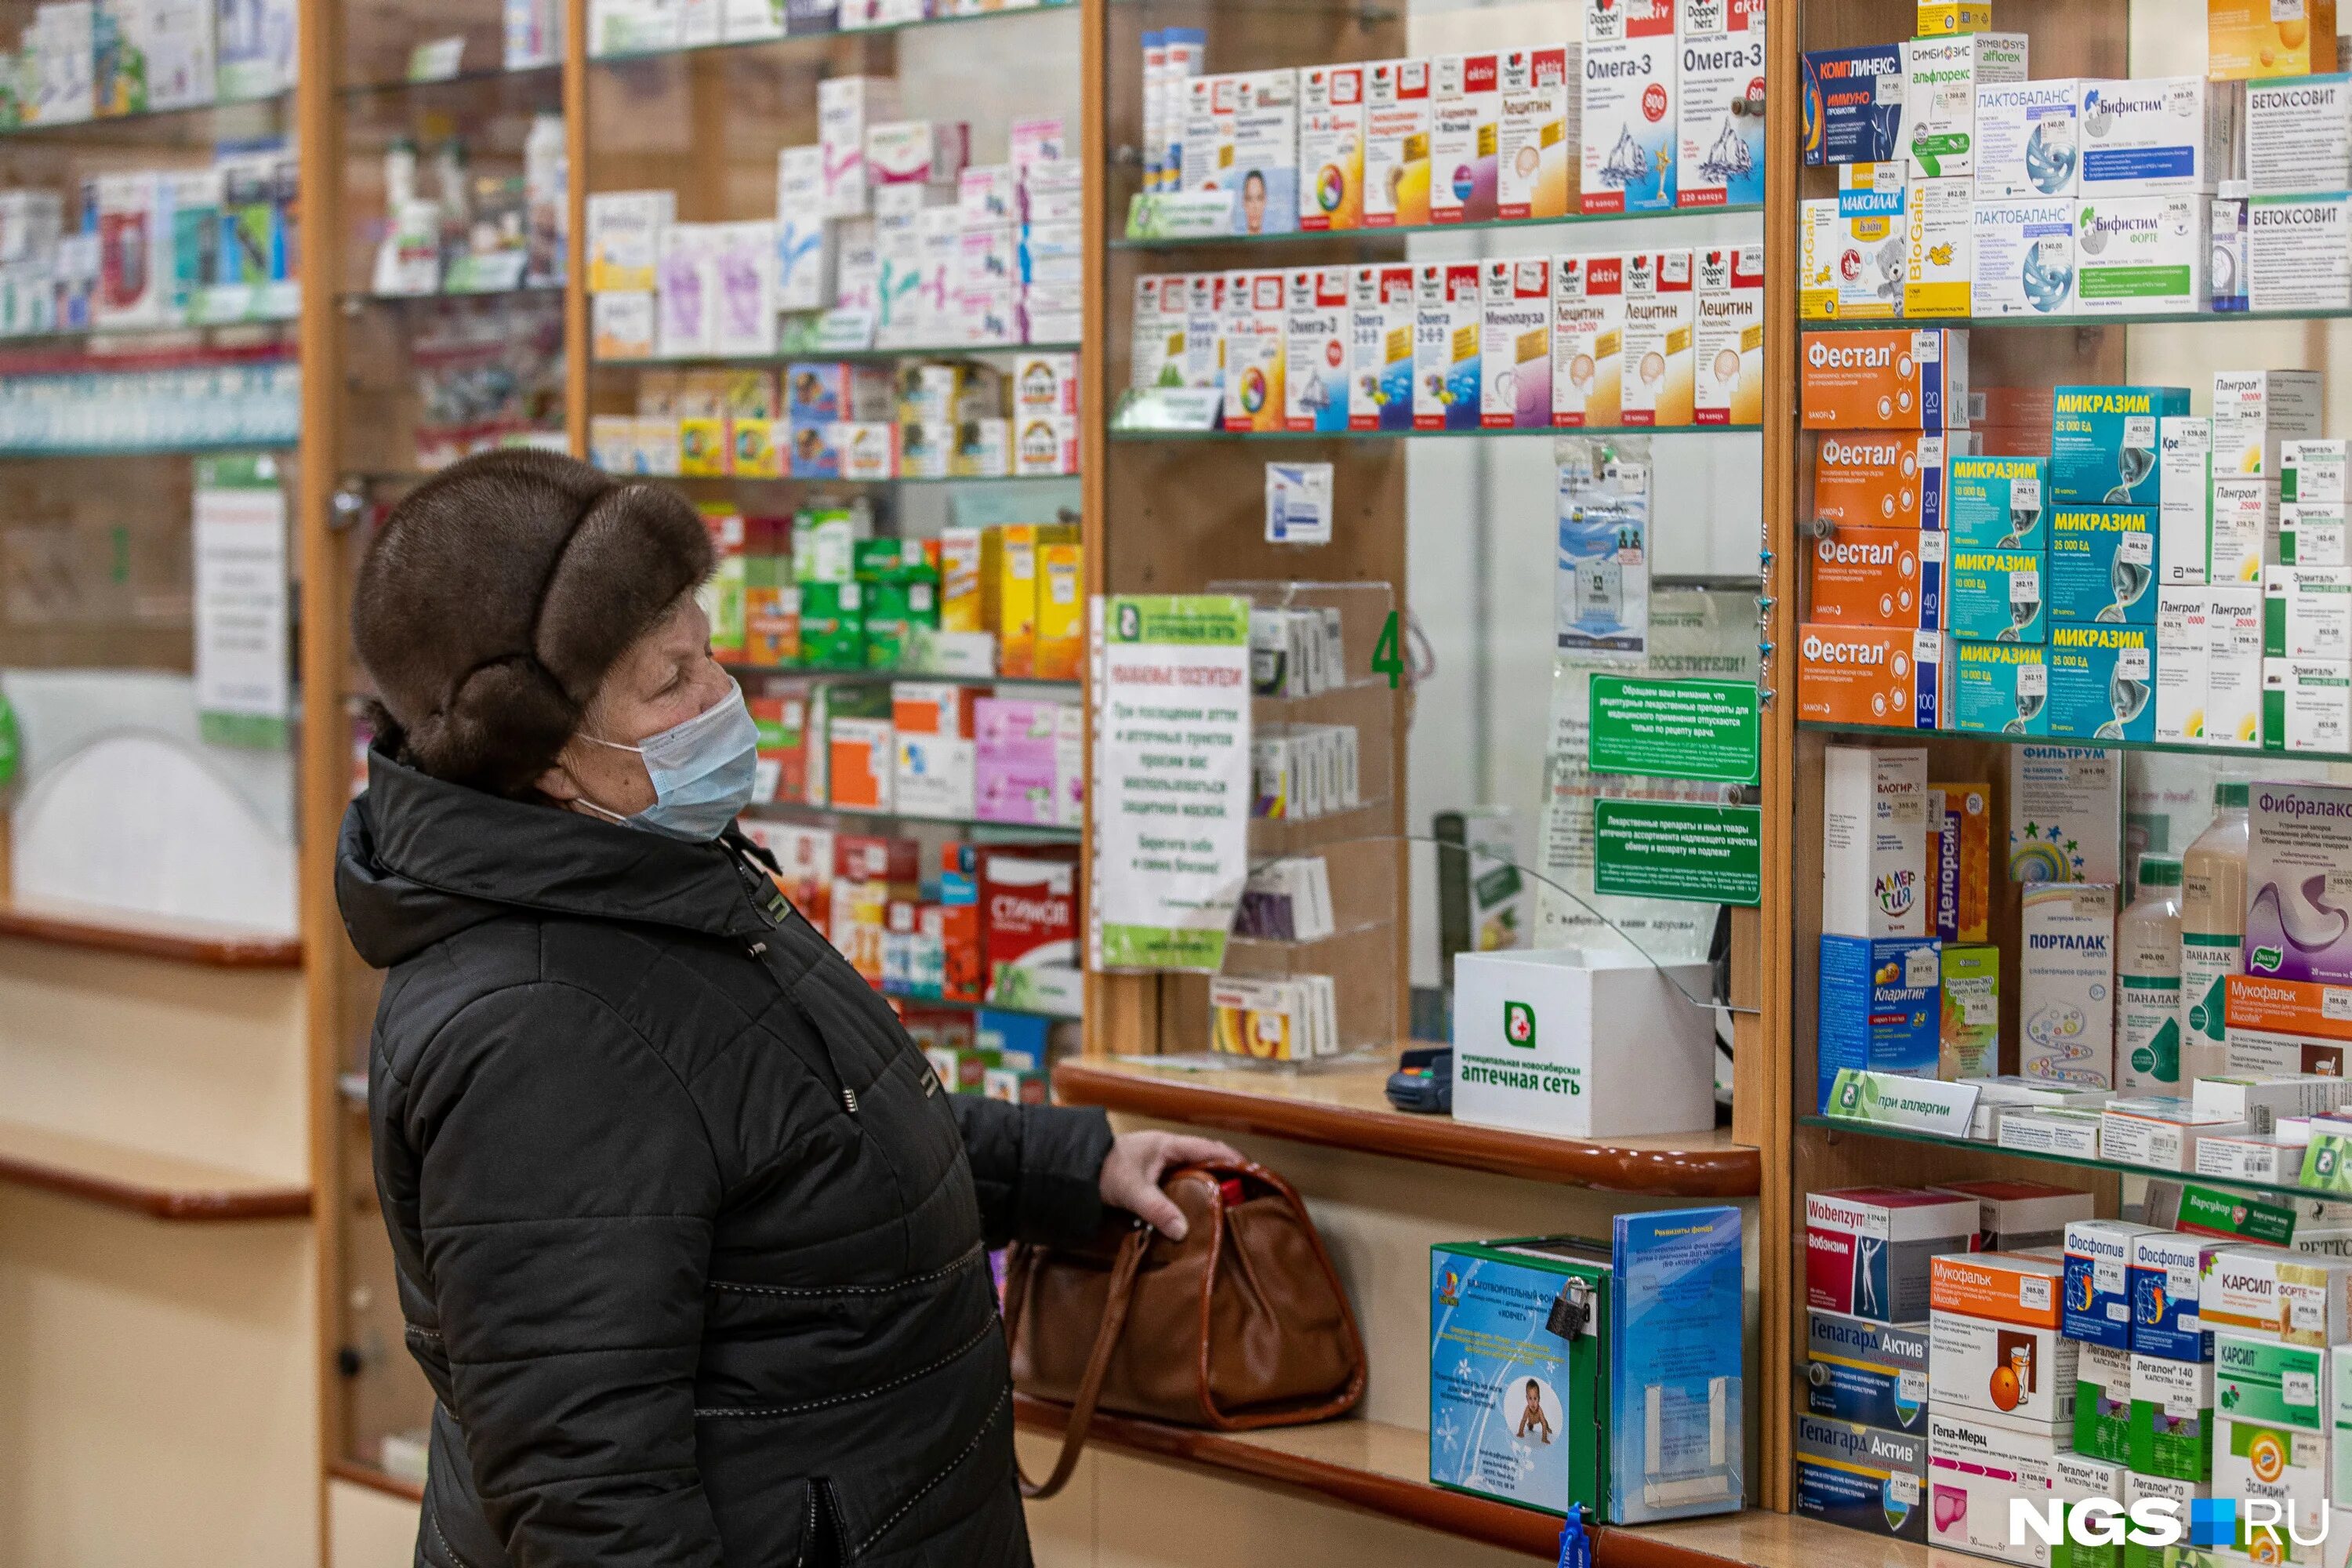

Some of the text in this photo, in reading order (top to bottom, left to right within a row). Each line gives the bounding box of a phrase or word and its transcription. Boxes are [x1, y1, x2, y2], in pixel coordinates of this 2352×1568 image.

[1590, 12, 1618, 31] Doppel
[1688, 5, 1719, 24] Doppel
[1693, 16, 1712, 29] herz
[1595, 25, 1613, 36] herz
[1683, 43, 1762, 72] Омега-3
[1983, 50, 2020, 62] alflorex
[1586, 54, 1652, 80] Омега-3
[1820, 56, 1896, 79] КОМПЛИНЕКС
[1912, 69, 1970, 85] альфлорекс
[1828, 91, 1870, 107] ИММУНО
[1977, 89, 2071, 108] ЛАКТОБАЛАНС
[2252, 89, 2336, 109] БЕТОКСОВИТ
[2100, 98, 2162, 117] Бифистим
[1842, 194, 1899, 211] МАКСИЛАК
[1973, 208, 2066, 225] ЛАКТОБАЛАНС
[2096, 215, 2158, 234] Бифистим
[2253, 208, 2337, 226] БЕТОКСОВИТ
[1909, 187, 1923, 281] BioGaia
[2129, 233, 2158, 244] ФОРТЕ
[1802, 206, 1815, 287] BioGaia
[1590, 270, 1619, 283] aktiv
[1628, 270, 1650, 281] Doppel
[1702, 266, 1725, 278] Doppel
[1706, 277, 1721, 286] herz
[1556, 307, 1604, 322] Лецитин
[1625, 303, 1677, 320] Лецитин
[1699, 300, 1752, 317] Лецитин
[1486, 312, 1544, 325] Менопауза
[1808, 341, 1891, 368] Фестал
[2216, 379, 2257, 392] Пангрол
[1925, 391, 1938, 408] 20
[2056, 394, 2150, 414] МИКРАЗИМ
[1808, 411, 1828, 419] SANOFI
[2056, 420, 2092, 433] 25 000 ЕД
[1822, 439, 1896, 466] Фестал
[1954, 462, 2037, 479] МИКРАЗИМ
[1925, 491, 1937, 507] 20
[2216, 487, 2257, 500] Пангрол
[2054, 513, 2146, 532] МИКРАЗИМ
[1818, 538, 1893, 564] Фестал
[2054, 540, 2089, 552] 25 000 ЕД
[1955, 554, 2037, 572] МИКРАЗИМ
[2293, 572, 2335, 583] Эрмиталь
[1922, 593, 1936, 608] 40
[2161, 601, 2201, 614] Пангрол
[2212, 604, 2252, 617] Пангрол
[2236, 618, 2257, 627] 25000
[2053, 628, 2144, 649] МИКРАЗИМ
[1370, 610, 1404, 690] 4
[1803, 635, 1884, 666] Фестал
[1960, 645, 2042, 665] МИКРАЗИМ
[2053, 655, 2088, 668] 25 000 ЕД
[2292, 666, 2332, 677] Эрмиталь
[1622, 685, 1725, 701] Обращаем ваше внимание, что
[1919, 693, 1935, 710] 100
[1600, 698, 1748, 715] рецептурные лекарственные препараты для
[1803, 703, 1824, 712] SANOFI
[1608, 710, 1740, 727] медицинского применения отпускаются
[1632, 724, 1715, 738] только по рецепту врача.
[2023, 747, 2105, 760] ФИЛЬТРУМ
[1878, 783, 1920, 793] БЛОГИР-3
[2259, 793, 2352, 819] Фибралакс
[1608, 815, 1658, 827] Лекарственные
[1659, 820, 1697, 832] препараты
[1722, 825, 1748, 835] товары
[2259, 828, 2299, 837] Восстановление
[1599, 829, 1757, 846] аптечного ассортимента надлежащего качества
[1624, 841, 1649, 854] обмену
[1656, 844, 1687, 857] возврату
[1698, 848, 1730, 857] подлежат
[1938, 816, 1958, 928] Делорсин
[2030, 934, 2106, 950] ПОРТАЛАК
[2187, 950, 2231, 961] ПАНАЛАК
[1875, 988, 1926, 1004] Кларитин
[2127, 993, 2180, 1004] ПАНАЛАК
[2231, 981, 2296, 1002] Мукофальк
[1461, 1052, 1581, 1076] муниципальная новосибирская
[1461, 1065, 1581, 1096] аптечная сеть
[1878, 1096, 1950, 1116] при аллергии
[1655, 1225, 1713, 1236] Реквизиты фонда
[1809, 1233, 1848, 1254] Вобэнзим
[2068, 1232, 2124, 1258] Фосфоглив
[2138, 1245, 2194, 1268] Фосфоглив
[1934, 1263, 1991, 1286] Мукофальк
[2222, 1273, 2307, 1298] КАРСИЛ ФОРТЕ
[1812, 1316, 1923, 1358] Гепагард Актив
[2087, 1343, 2120, 1359] Легалон
[2221, 1345, 2255, 1367] КАРСИЛ
[2093, 1357, 2119, 1368] КАПСУЛЫ
[2136, 1360, 2193, 1377] Легалон 140
[1908, 1380, 1925, 1388] 247.00
[2145, 1374, 2173, 1384] КАПСУЛЫ
[1800, 1417, 1913, 1461] Гепагард Актив
[1933, 1423, 1987, 1446] Гепа-Мерц
[2057, 1463, 2108, 1483] Легалон 140
[2064, 1475, 2091, 1488] КАПСУЛЫ
[1900, 1481, 1916, 1490] 247.00
[2132, 1477, 2183, 1496] Легалон 70
[1969, 1537, 1977, 1546] 30
